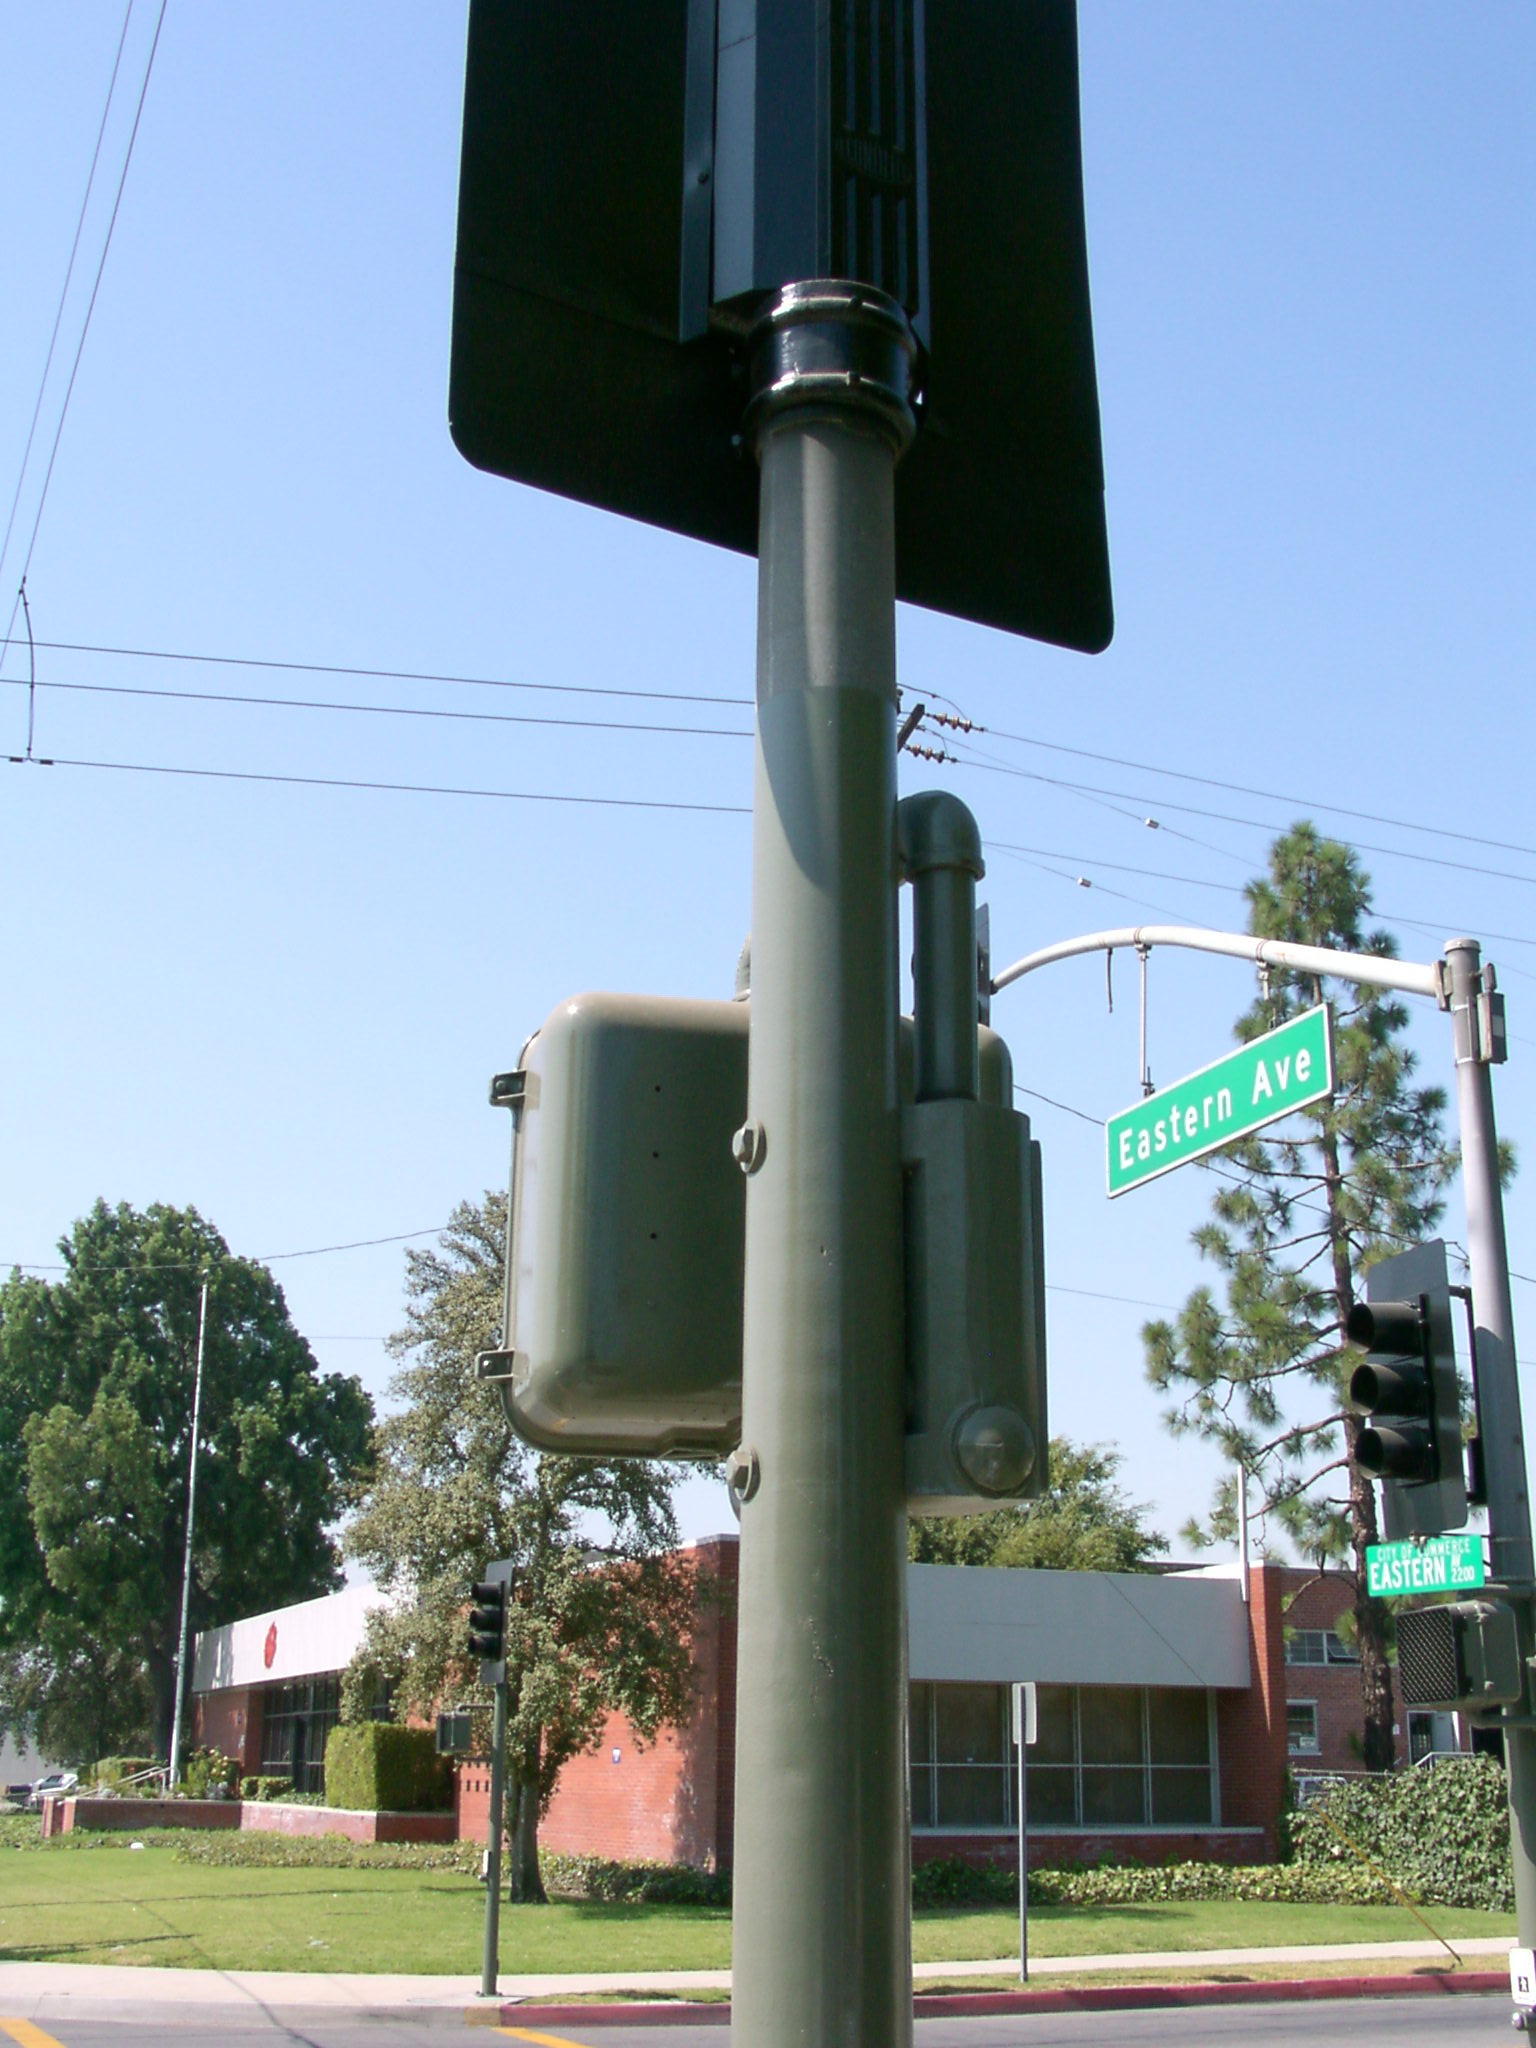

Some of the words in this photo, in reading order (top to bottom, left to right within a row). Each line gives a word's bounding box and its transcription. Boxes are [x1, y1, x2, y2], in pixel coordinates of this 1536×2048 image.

[1119, 1088, 1232, 1170] Eastern
[1252, 1048, 1311, 1105] Ave
[1377, 1547, 1397, 1562] CITY
[1402, 1544, 1413, 1560] OF
[1370, 1556, 1446, 1590] EASTERN
[1451, 1565, 1475, 1583] 2200
